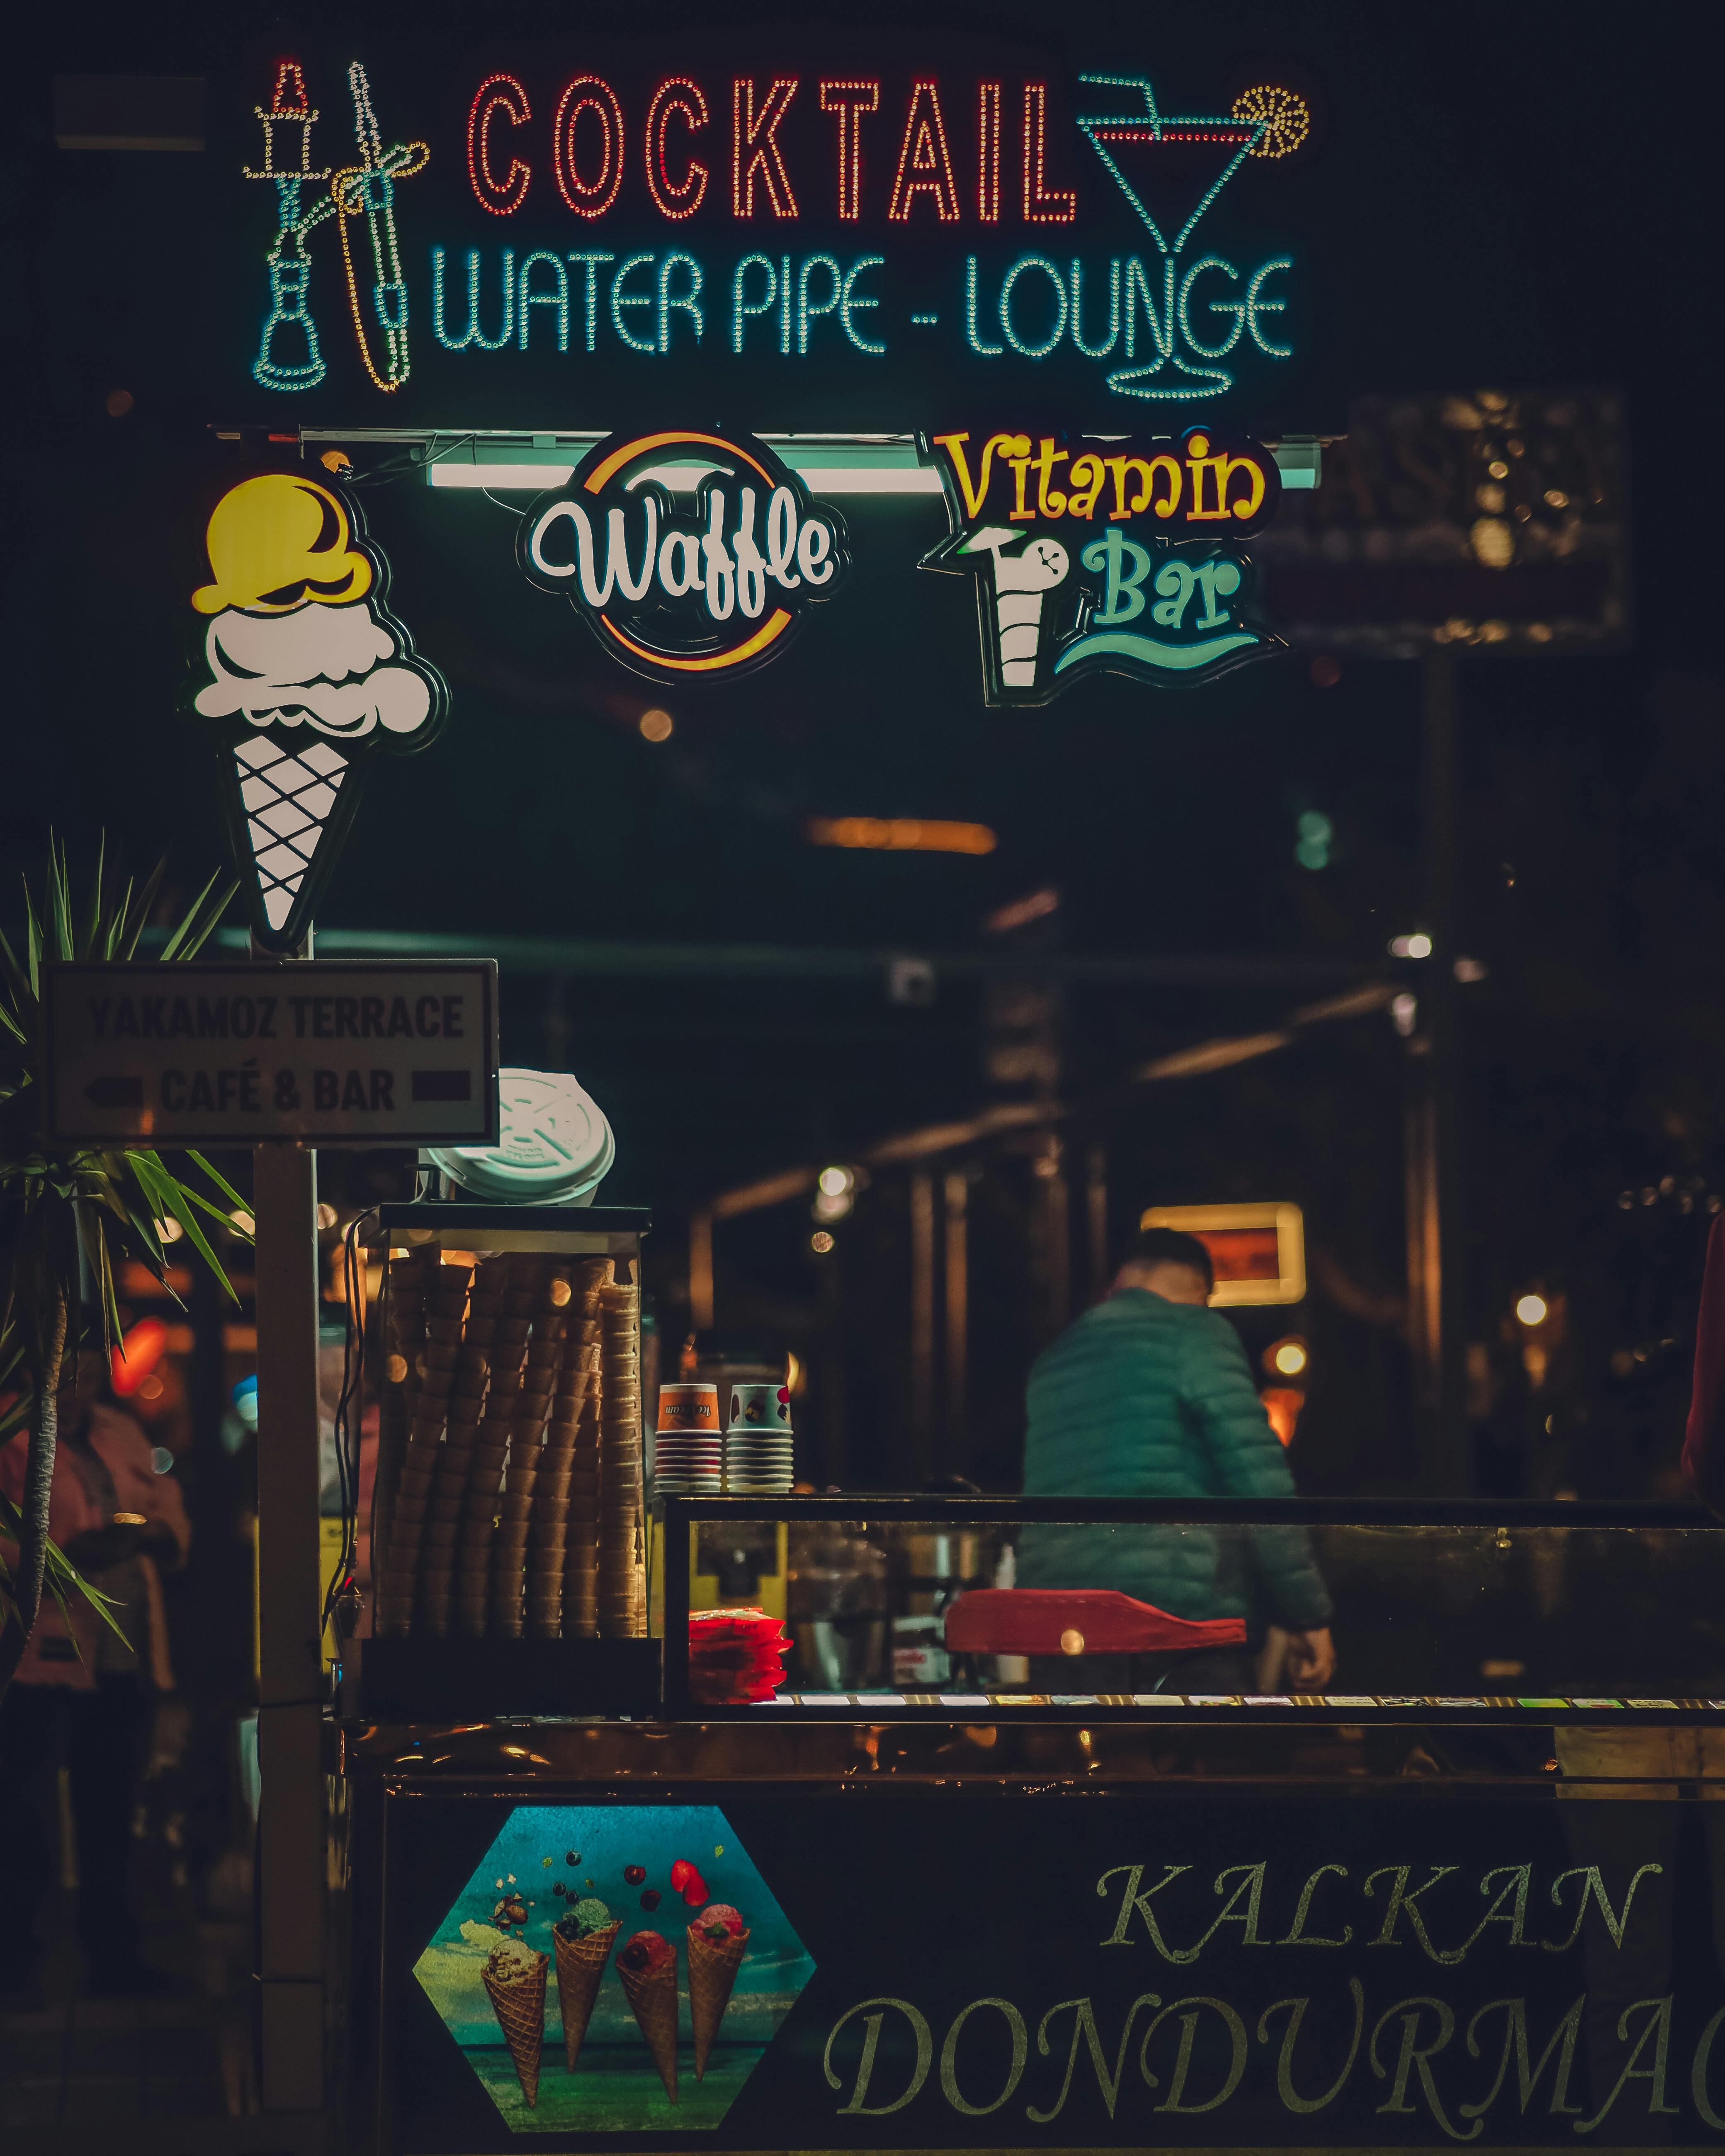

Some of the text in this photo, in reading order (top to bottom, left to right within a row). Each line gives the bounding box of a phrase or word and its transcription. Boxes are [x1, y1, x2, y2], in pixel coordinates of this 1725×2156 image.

[467, 74, 1077, 221] COCKTAIL
[431, 251, 704, 356] WATER
[734, 254, 886, 356] PIPE
[966, 254, 1294, 357] LOUNGE
[933, 431, 1265, 521] Vitamin
[531, 487, 833, 620] Waffle
[1081, 528, 1241, 630] Bar
[87, 995, 464, 1039] YAKAMOZ TERRACE
[160, 1056, 396, 1112] CAFÉ & BAR
[1096, 1860, 1663, 1964] KALKAN
